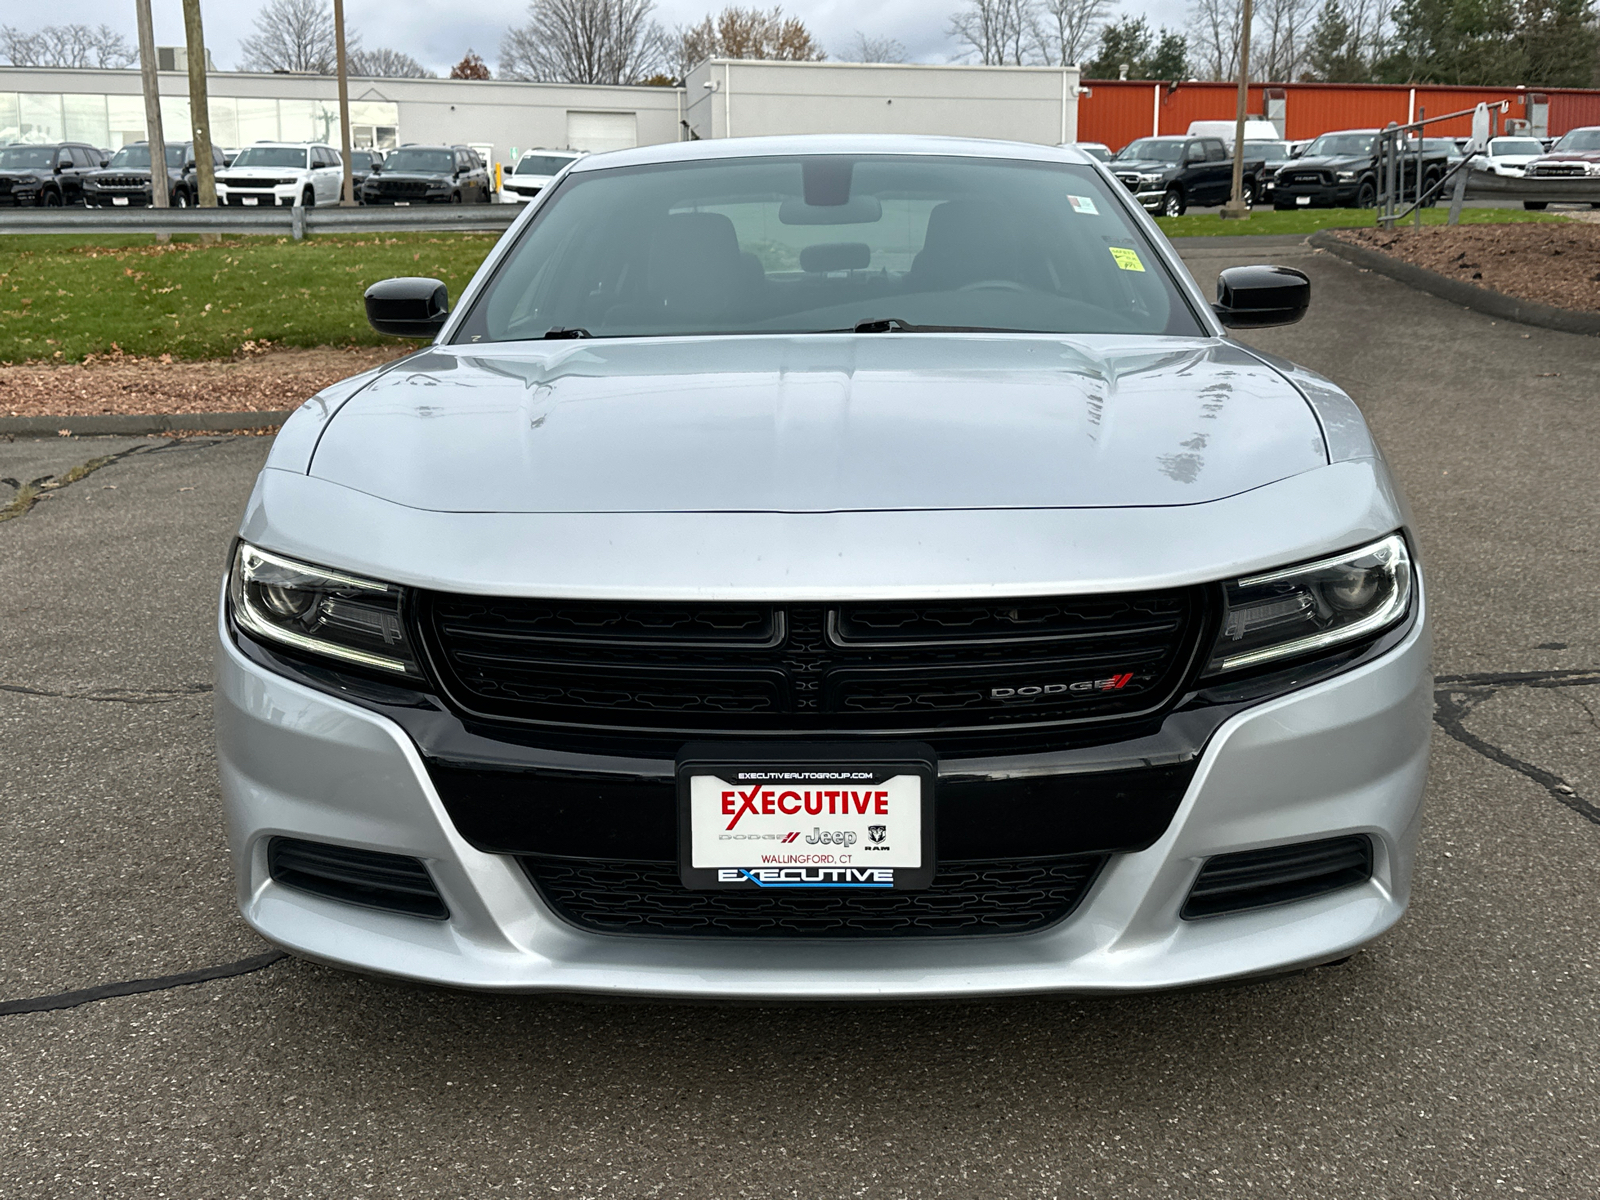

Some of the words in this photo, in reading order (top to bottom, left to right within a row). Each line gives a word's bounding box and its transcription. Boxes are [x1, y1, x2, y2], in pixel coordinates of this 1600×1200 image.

[991, 678, 1116, 697] DODGE
[721, 785, 889, 830] EXECUTIVE
[805, 827, 858, 847] Jeep
[761, 854, 837, 864] WALLINGFORD,
[839, 854, 852, 864] CT
[718, 868, 894, 885] EXECUTIVE
